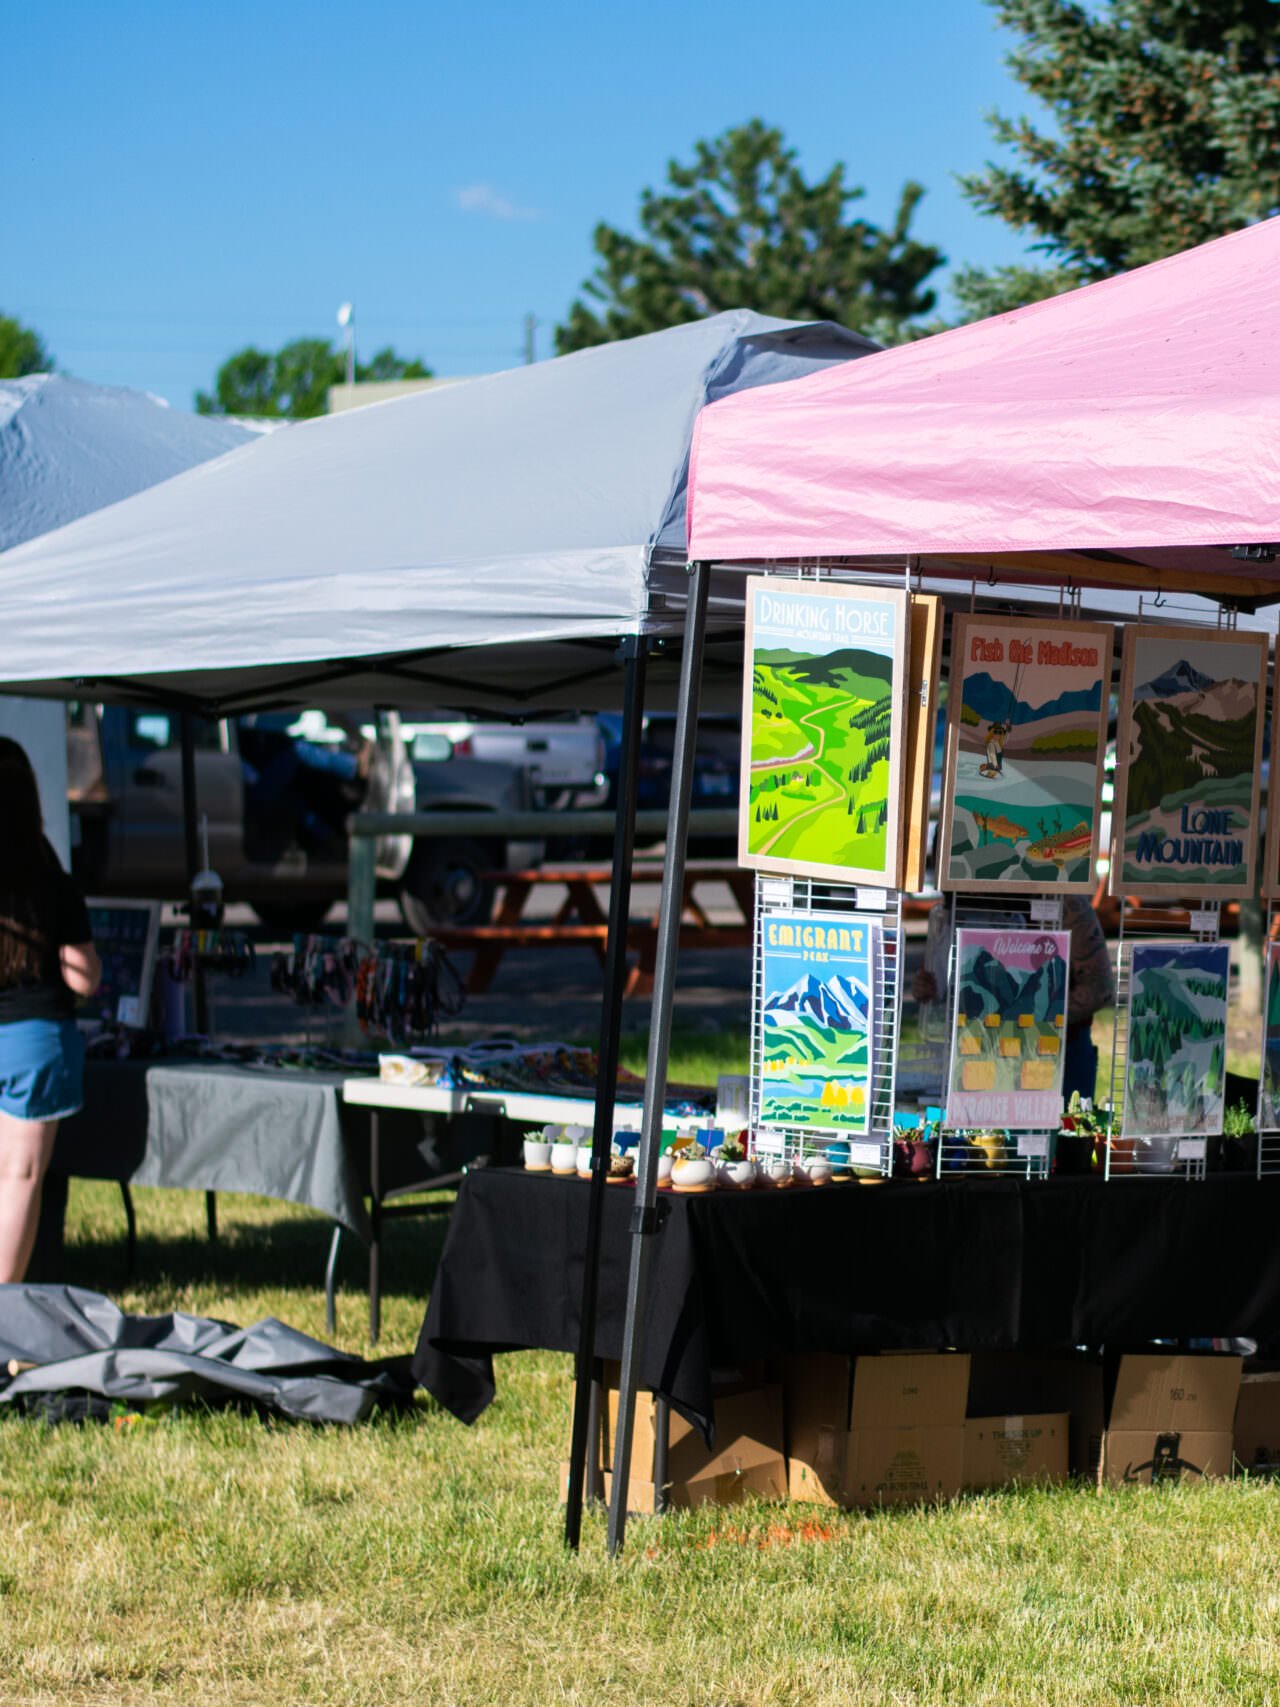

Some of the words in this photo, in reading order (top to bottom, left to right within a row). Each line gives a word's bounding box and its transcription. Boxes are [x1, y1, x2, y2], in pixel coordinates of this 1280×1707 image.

[761, 594, 830, 631] DRINKING
[835, 603, 889, 636] HORSE
[970, 637, 1004, 662] Fish
[1009, 639, 1033, 664] the
[1037, 640, 1098, 667] Madison
[1181, 802, 1234, 836] LONE
[1135, 832, 1244, 867] MOUNTAIN
[768, 923, 863, 952] EMIGRANT
[993, 937, 1043, 955] Welcome
[1043, 938, 1057, 955] to
